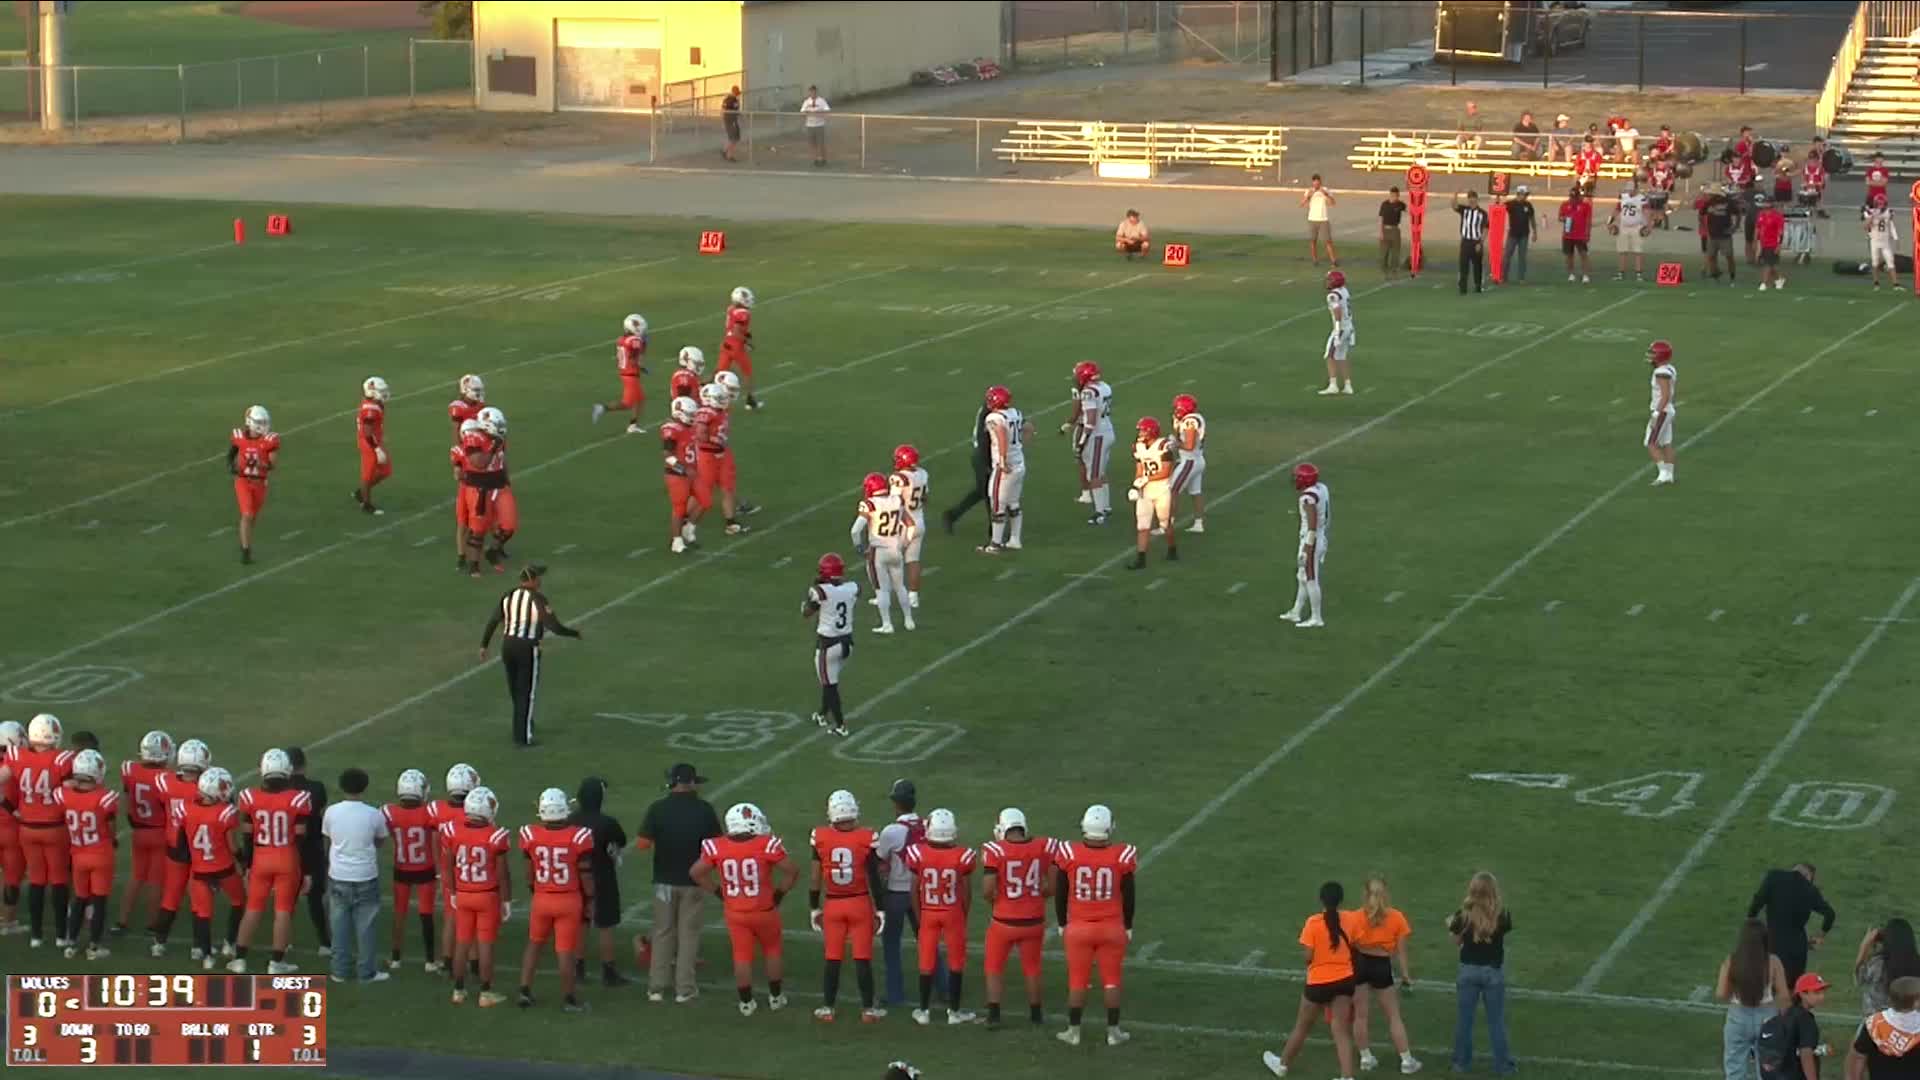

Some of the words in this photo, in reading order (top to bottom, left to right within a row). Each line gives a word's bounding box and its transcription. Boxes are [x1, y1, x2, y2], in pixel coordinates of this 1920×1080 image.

[1493, 173, 1506, 191] 3
[1622, 204, 1637, 217] 75
[703, 233, 720, 249] 10
[1167, 246, 1184, 262] 20
[1660, 266, 1678, 281] 30
[878, 509, 901, 537] 27
[836, 601, 847, 629] 3
[19, 767, 54, 806] 44
[135, 783, 152, 818] 5
[65, 809, 99, 846] 22
[192, 823, 215, 861] 4
[254, 809, 289, 847] 30
[395, 826, 427, 864] 12
[456, 845, 488, 883] 42
[535, 846, 570, 885] 35
[722, 857, 760, 897] 99
[831, 847, 853, 885] 3
[1005, 858, 1041, 898] 54
[922, 867, 957, 906] 23
[1075, 865, 1113, 901] 60
